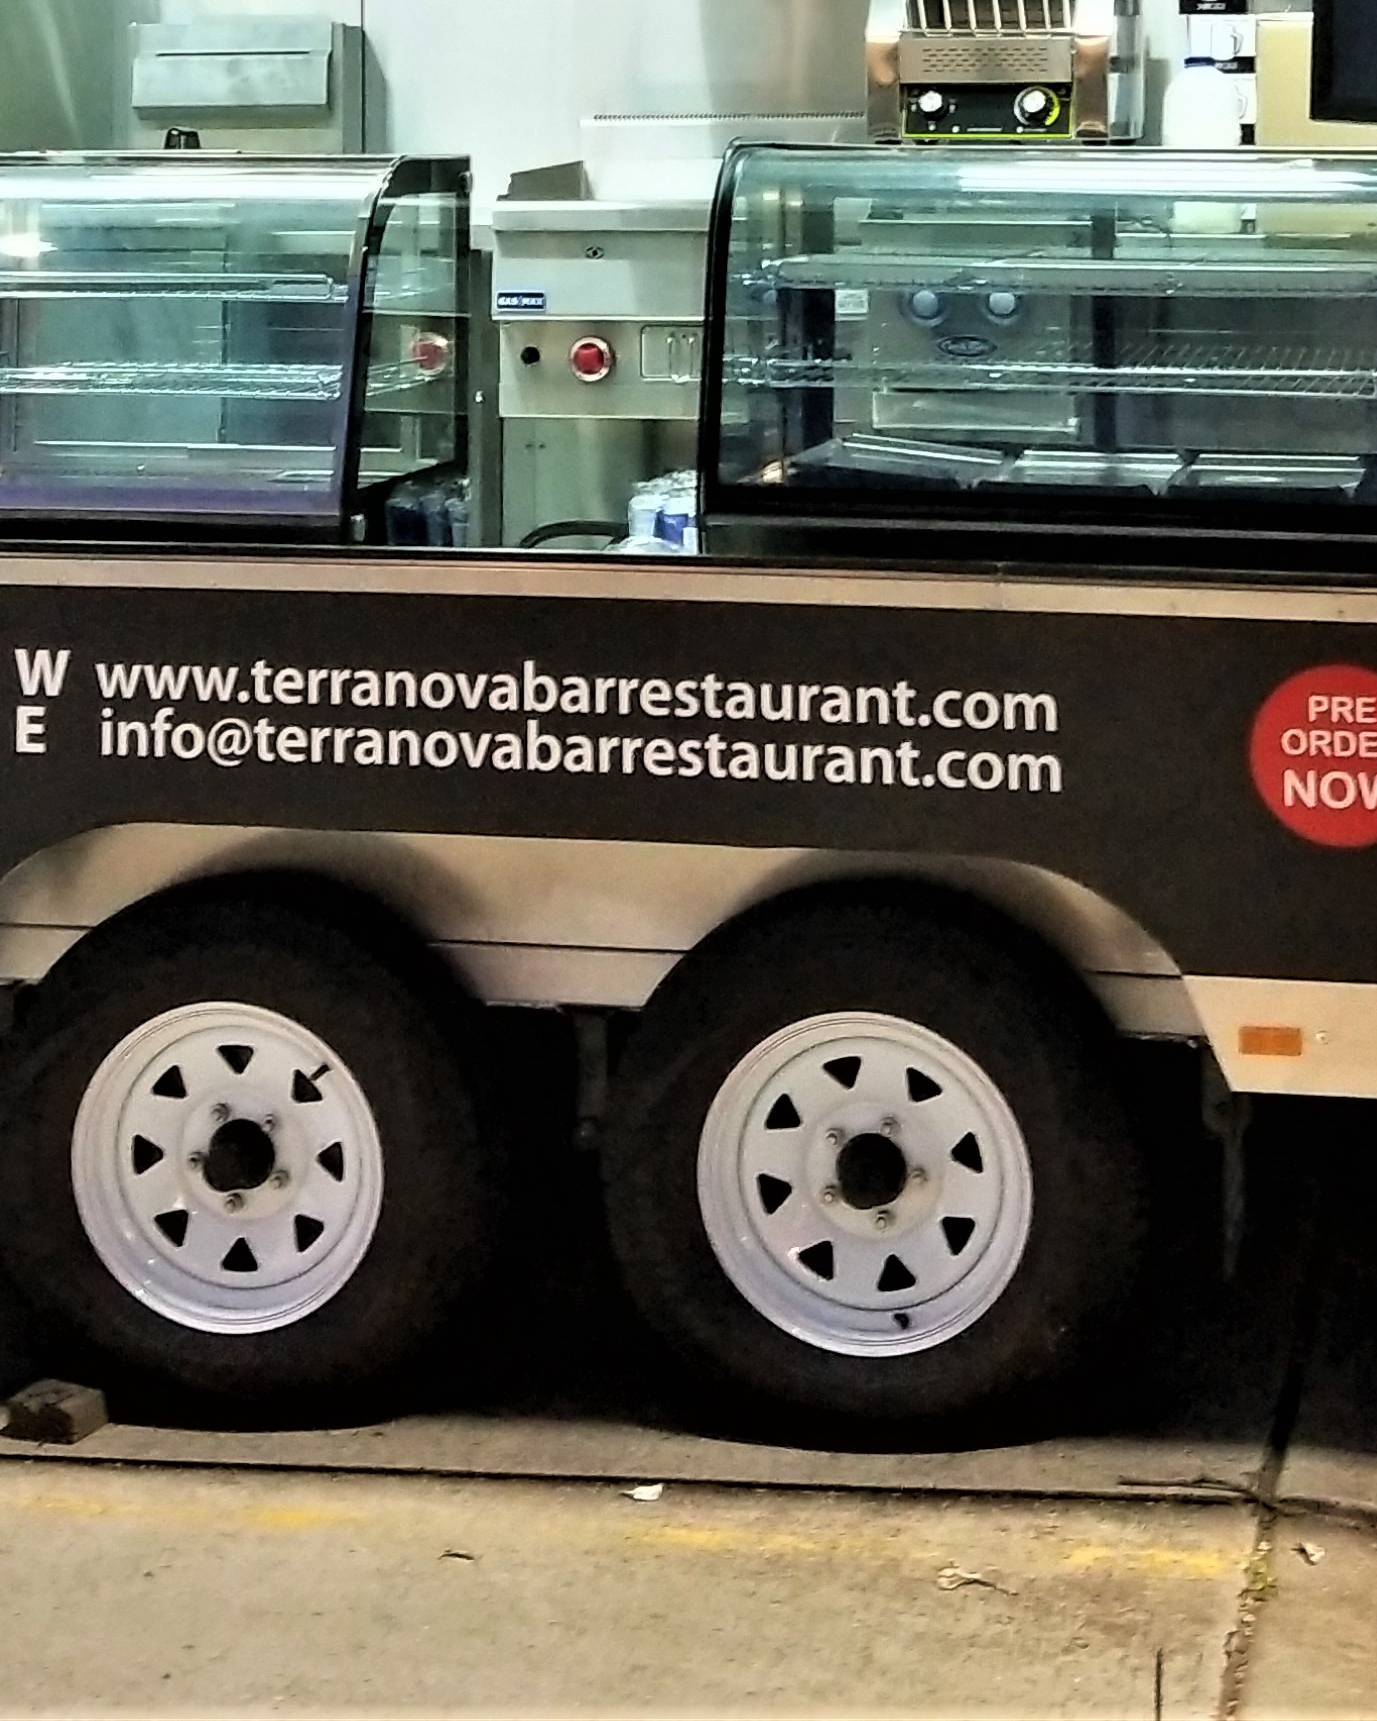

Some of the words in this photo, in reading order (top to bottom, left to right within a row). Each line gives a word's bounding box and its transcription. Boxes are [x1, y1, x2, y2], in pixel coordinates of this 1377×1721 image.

[14, 648, 71, 697] W
[95, 659, 1059, 734] www.terranovabarrestaurant.com
[15, 705, 47, 754] E
[100, 706, 1063, 793] info@terranovabarrestaurant.com
